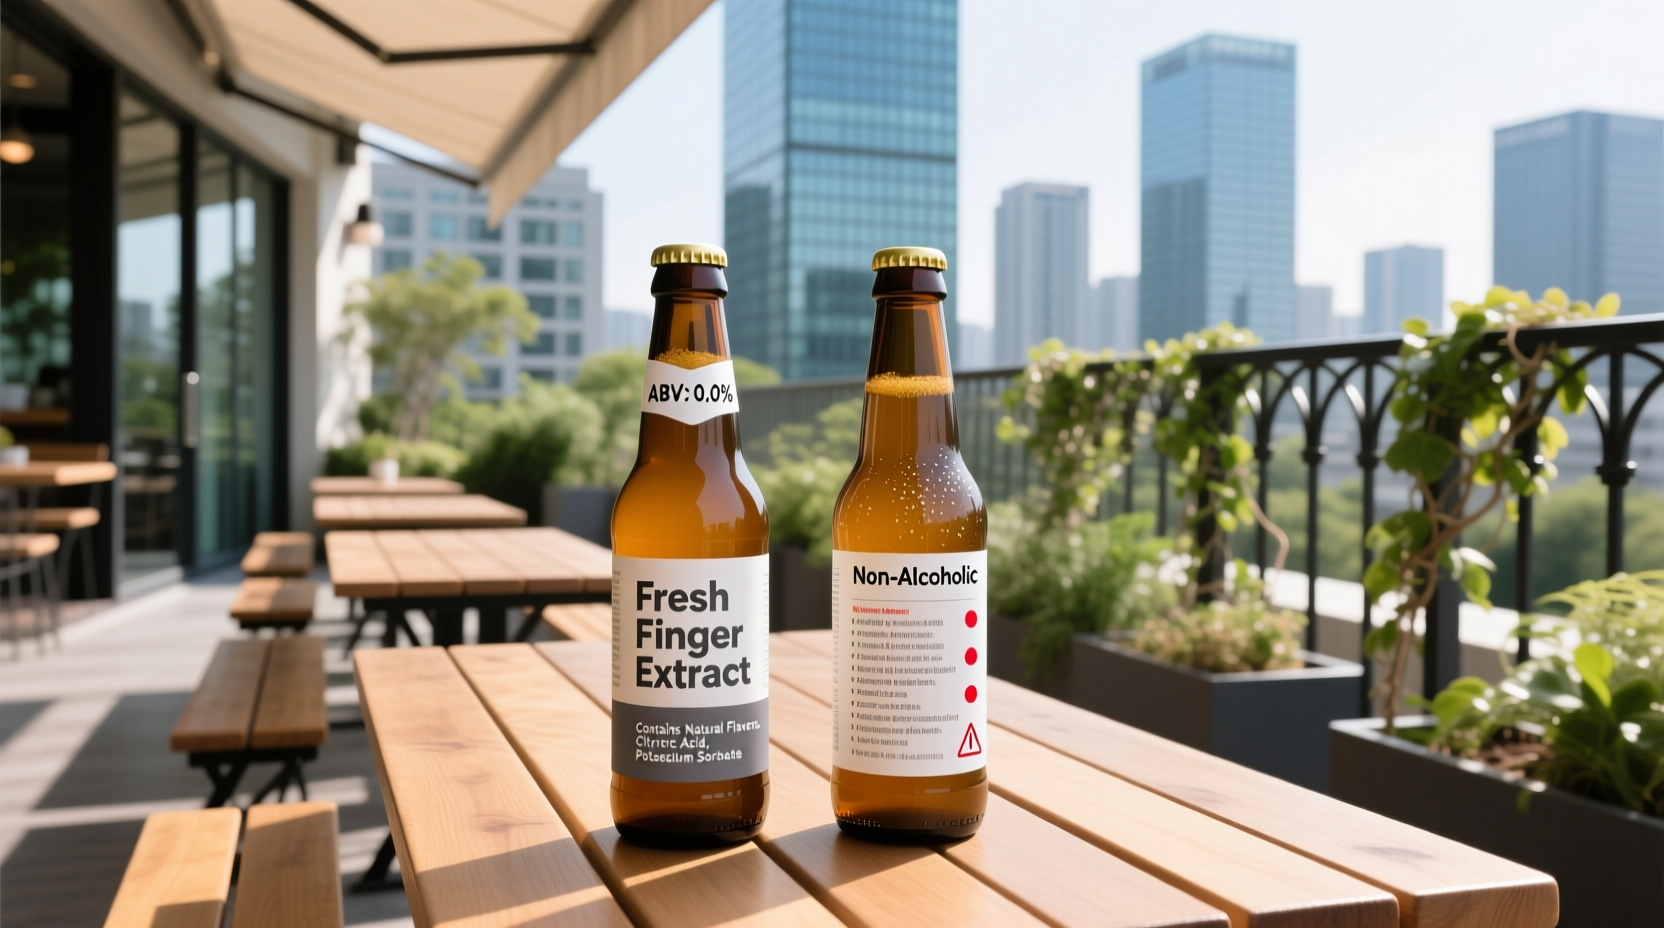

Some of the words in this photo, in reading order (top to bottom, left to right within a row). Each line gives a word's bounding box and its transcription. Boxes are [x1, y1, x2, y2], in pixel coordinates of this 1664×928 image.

[648, 383, 690, 403] ABV:
[694, 383, 733, 403] 0.0%
[853, 565, 979, 586] Non-Alcoholic
[636, 580, 729, 612] Fresh
[636, 618, 744, 659] Finger
[636, 656, 752, 689] Extract
[685, 722, 724, 736] Natural
